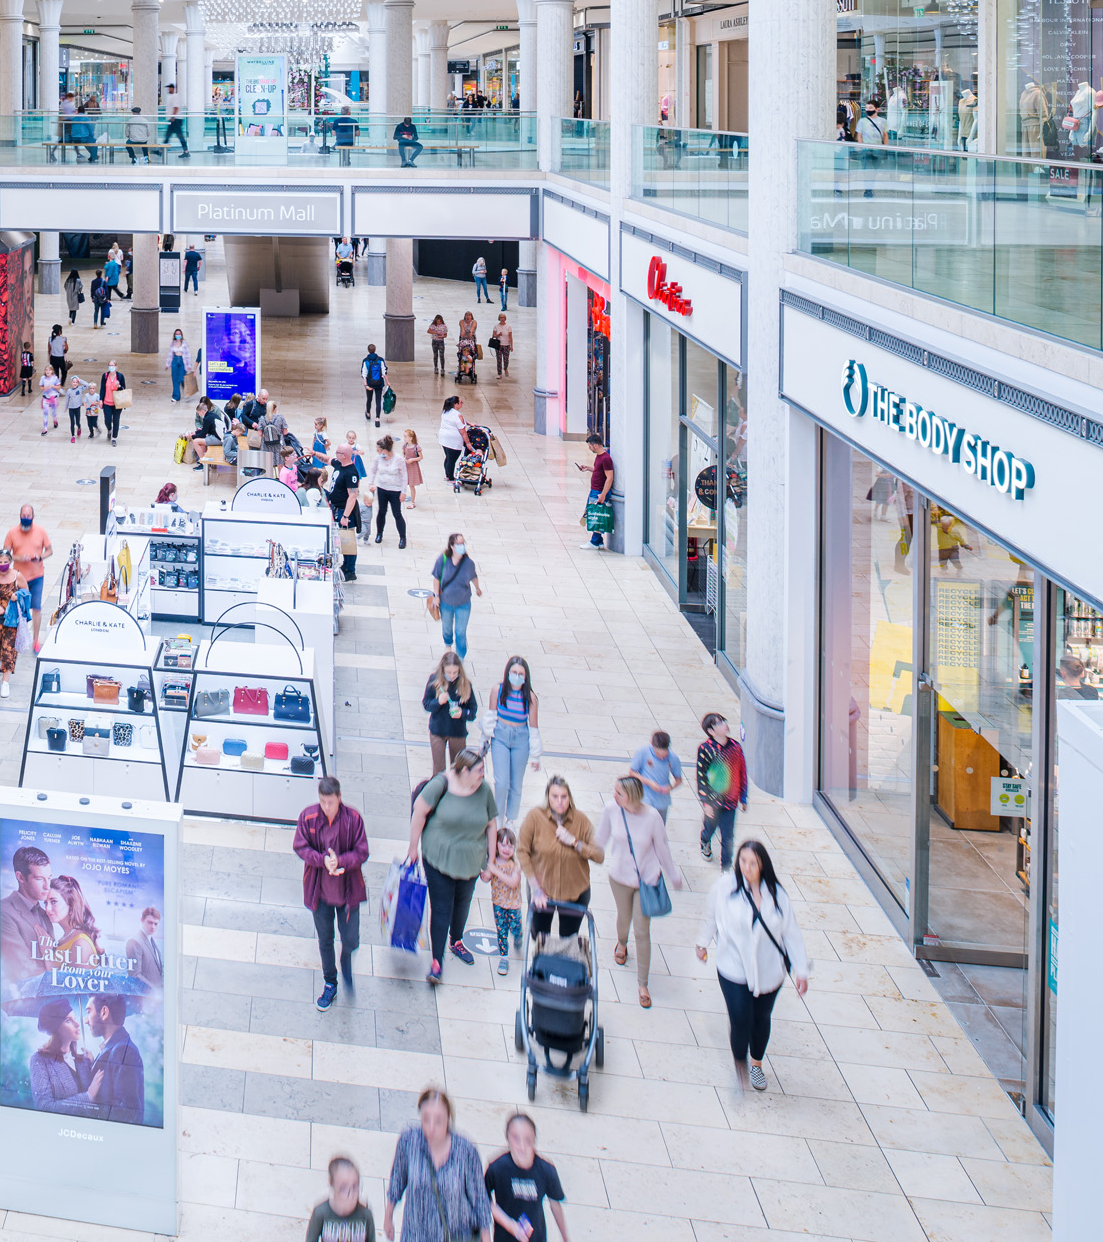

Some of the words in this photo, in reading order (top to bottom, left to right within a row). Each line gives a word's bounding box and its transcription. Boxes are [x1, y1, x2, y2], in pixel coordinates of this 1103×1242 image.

[720, 19, 733, 30] LAURA
[733, 16, 748, 28] ASHLEY
[245, 84, 277, 94] CLEN-UP
[1050, 168, 1070, 180] SALE
[198, 203, 274, 220] Platinum
[279, 204, 315, 221] Mall
[867, 382, 906, 433] THE
[905, 402, 966, 464] BODY
[963, 434, 1036, 501] SHOP
[75, 619, 101, 627] CHARLIE
[81, 863, 102, 871] JOJO
[103, 865, 130, 874] MOYES
[40, 936, 58, 947] The
[31, 940, 72, 964] Last
[75, 946, 137, 971] Letter
[60, 963, 85, 975] from
[88, 969, 113, 979] your
[51, 967, 108, 992] Lover
[58, 1128, 104, 1142] JCDecaux
